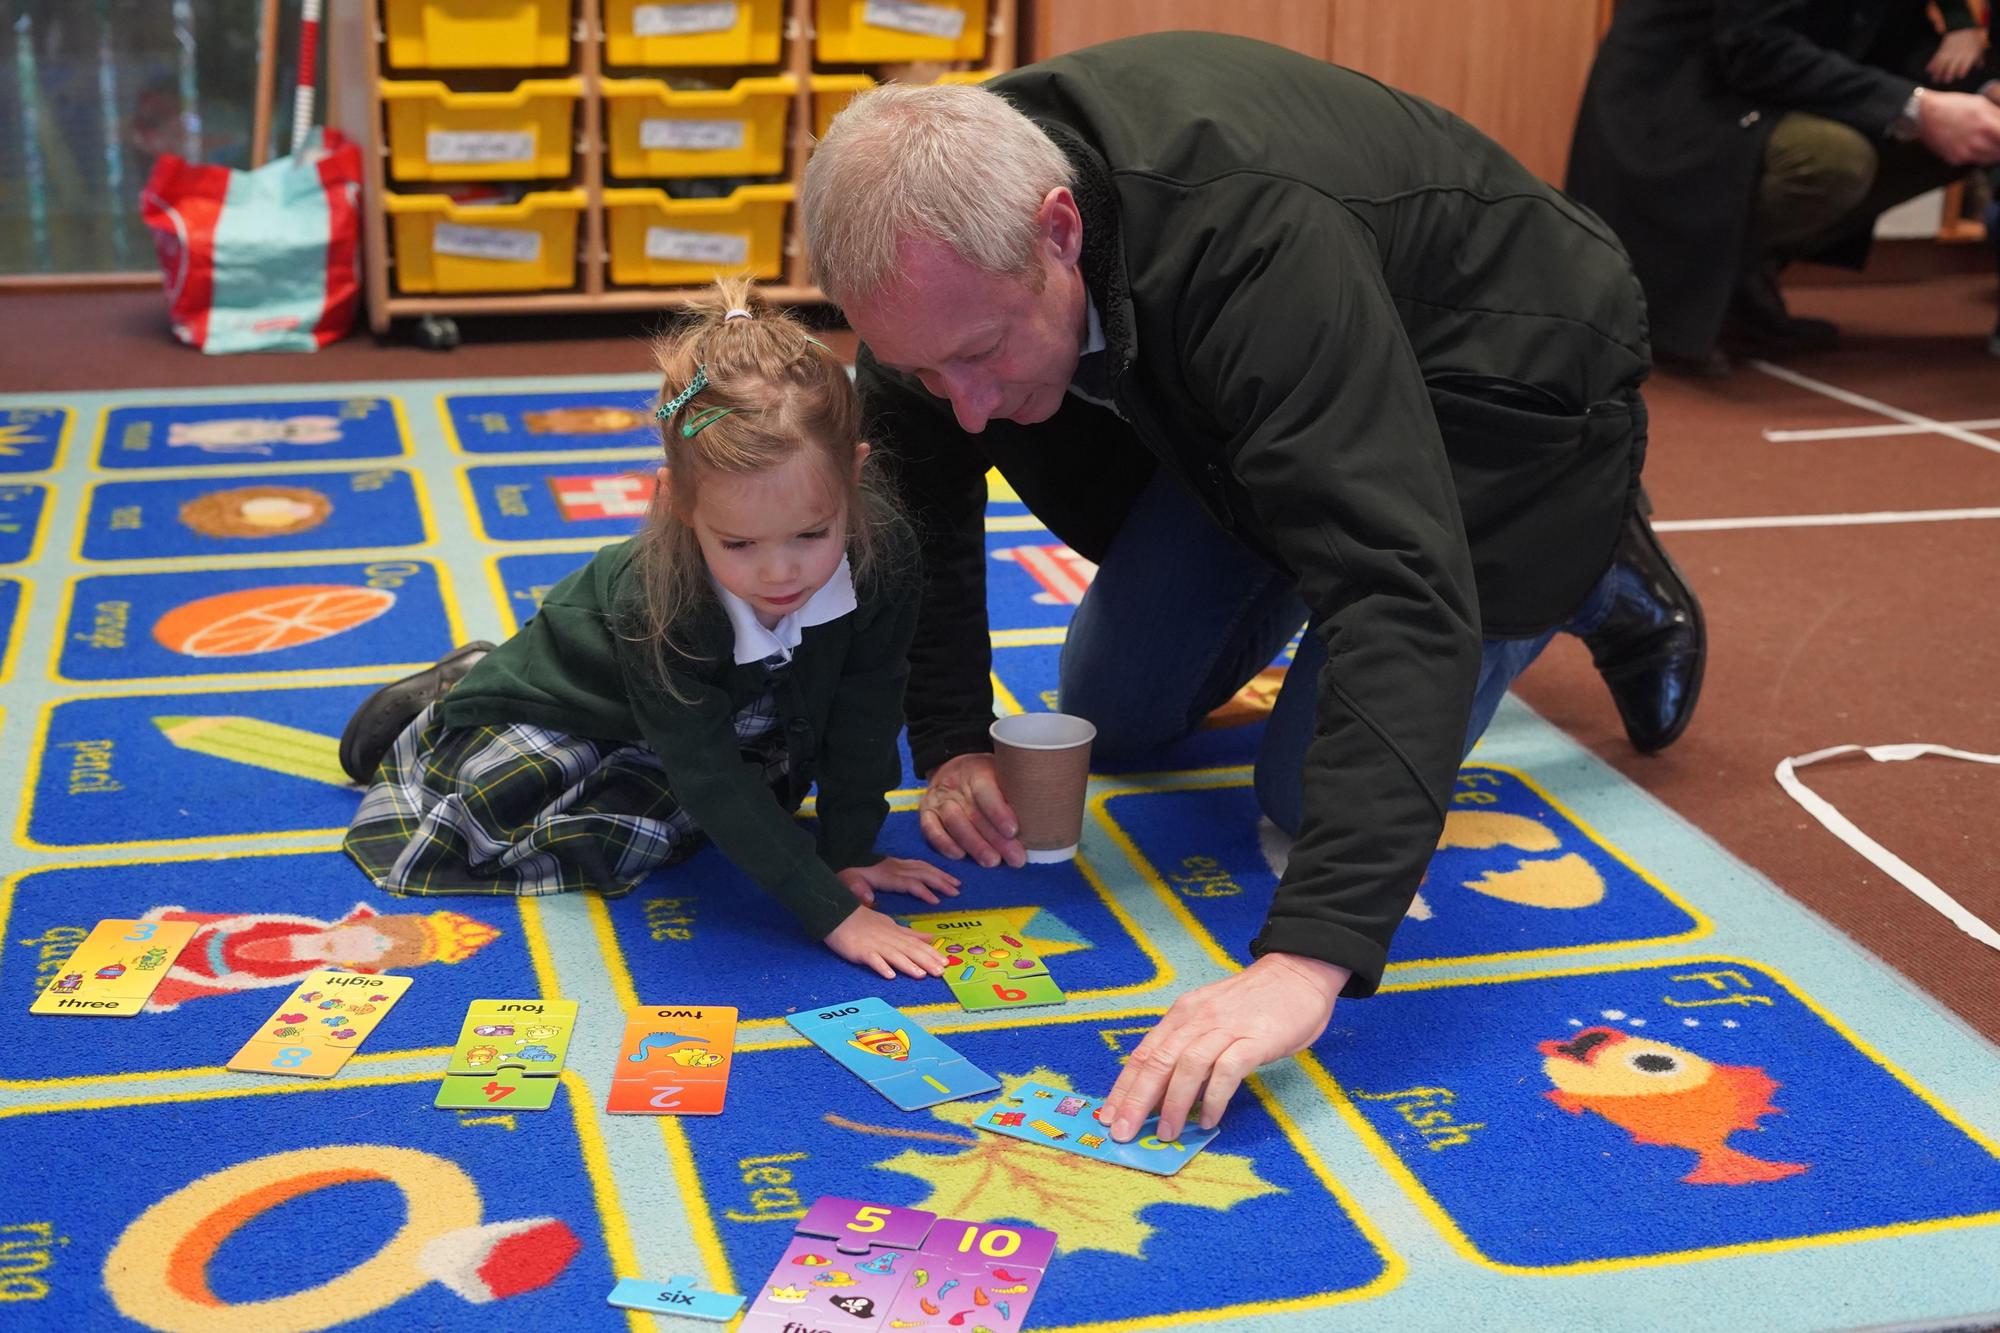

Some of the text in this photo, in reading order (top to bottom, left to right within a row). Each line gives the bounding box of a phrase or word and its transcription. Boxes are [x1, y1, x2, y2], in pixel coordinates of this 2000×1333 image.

[56, 740, 129, 796] pencil
[644, 897, 698, 941] kite
[936, 920, 982, 930] nine
[123, 923, 159, 942] 3
[326, 976, 384, 989] eight
[57, 998, 120, 1009] three
[496, 1004, 546, 1015] four
[818, 1006, 860, 1021] one
[657, 1010, 703, 1020] two
[271, 1047, 313, 1069] 8
[481, 1081, 517, 1103] 4
[921, 1074, 951, 1095] 1
[649, 1086, 685, 1108] 2
[1350, 1086, 1487, 1152] fish
[726, 1151, 811, 1222] leaf
[846, 1206, 892, 1233] 5
[957, 1226, 1022, 1258] 10
[656, 1290, 696, 1306] six
